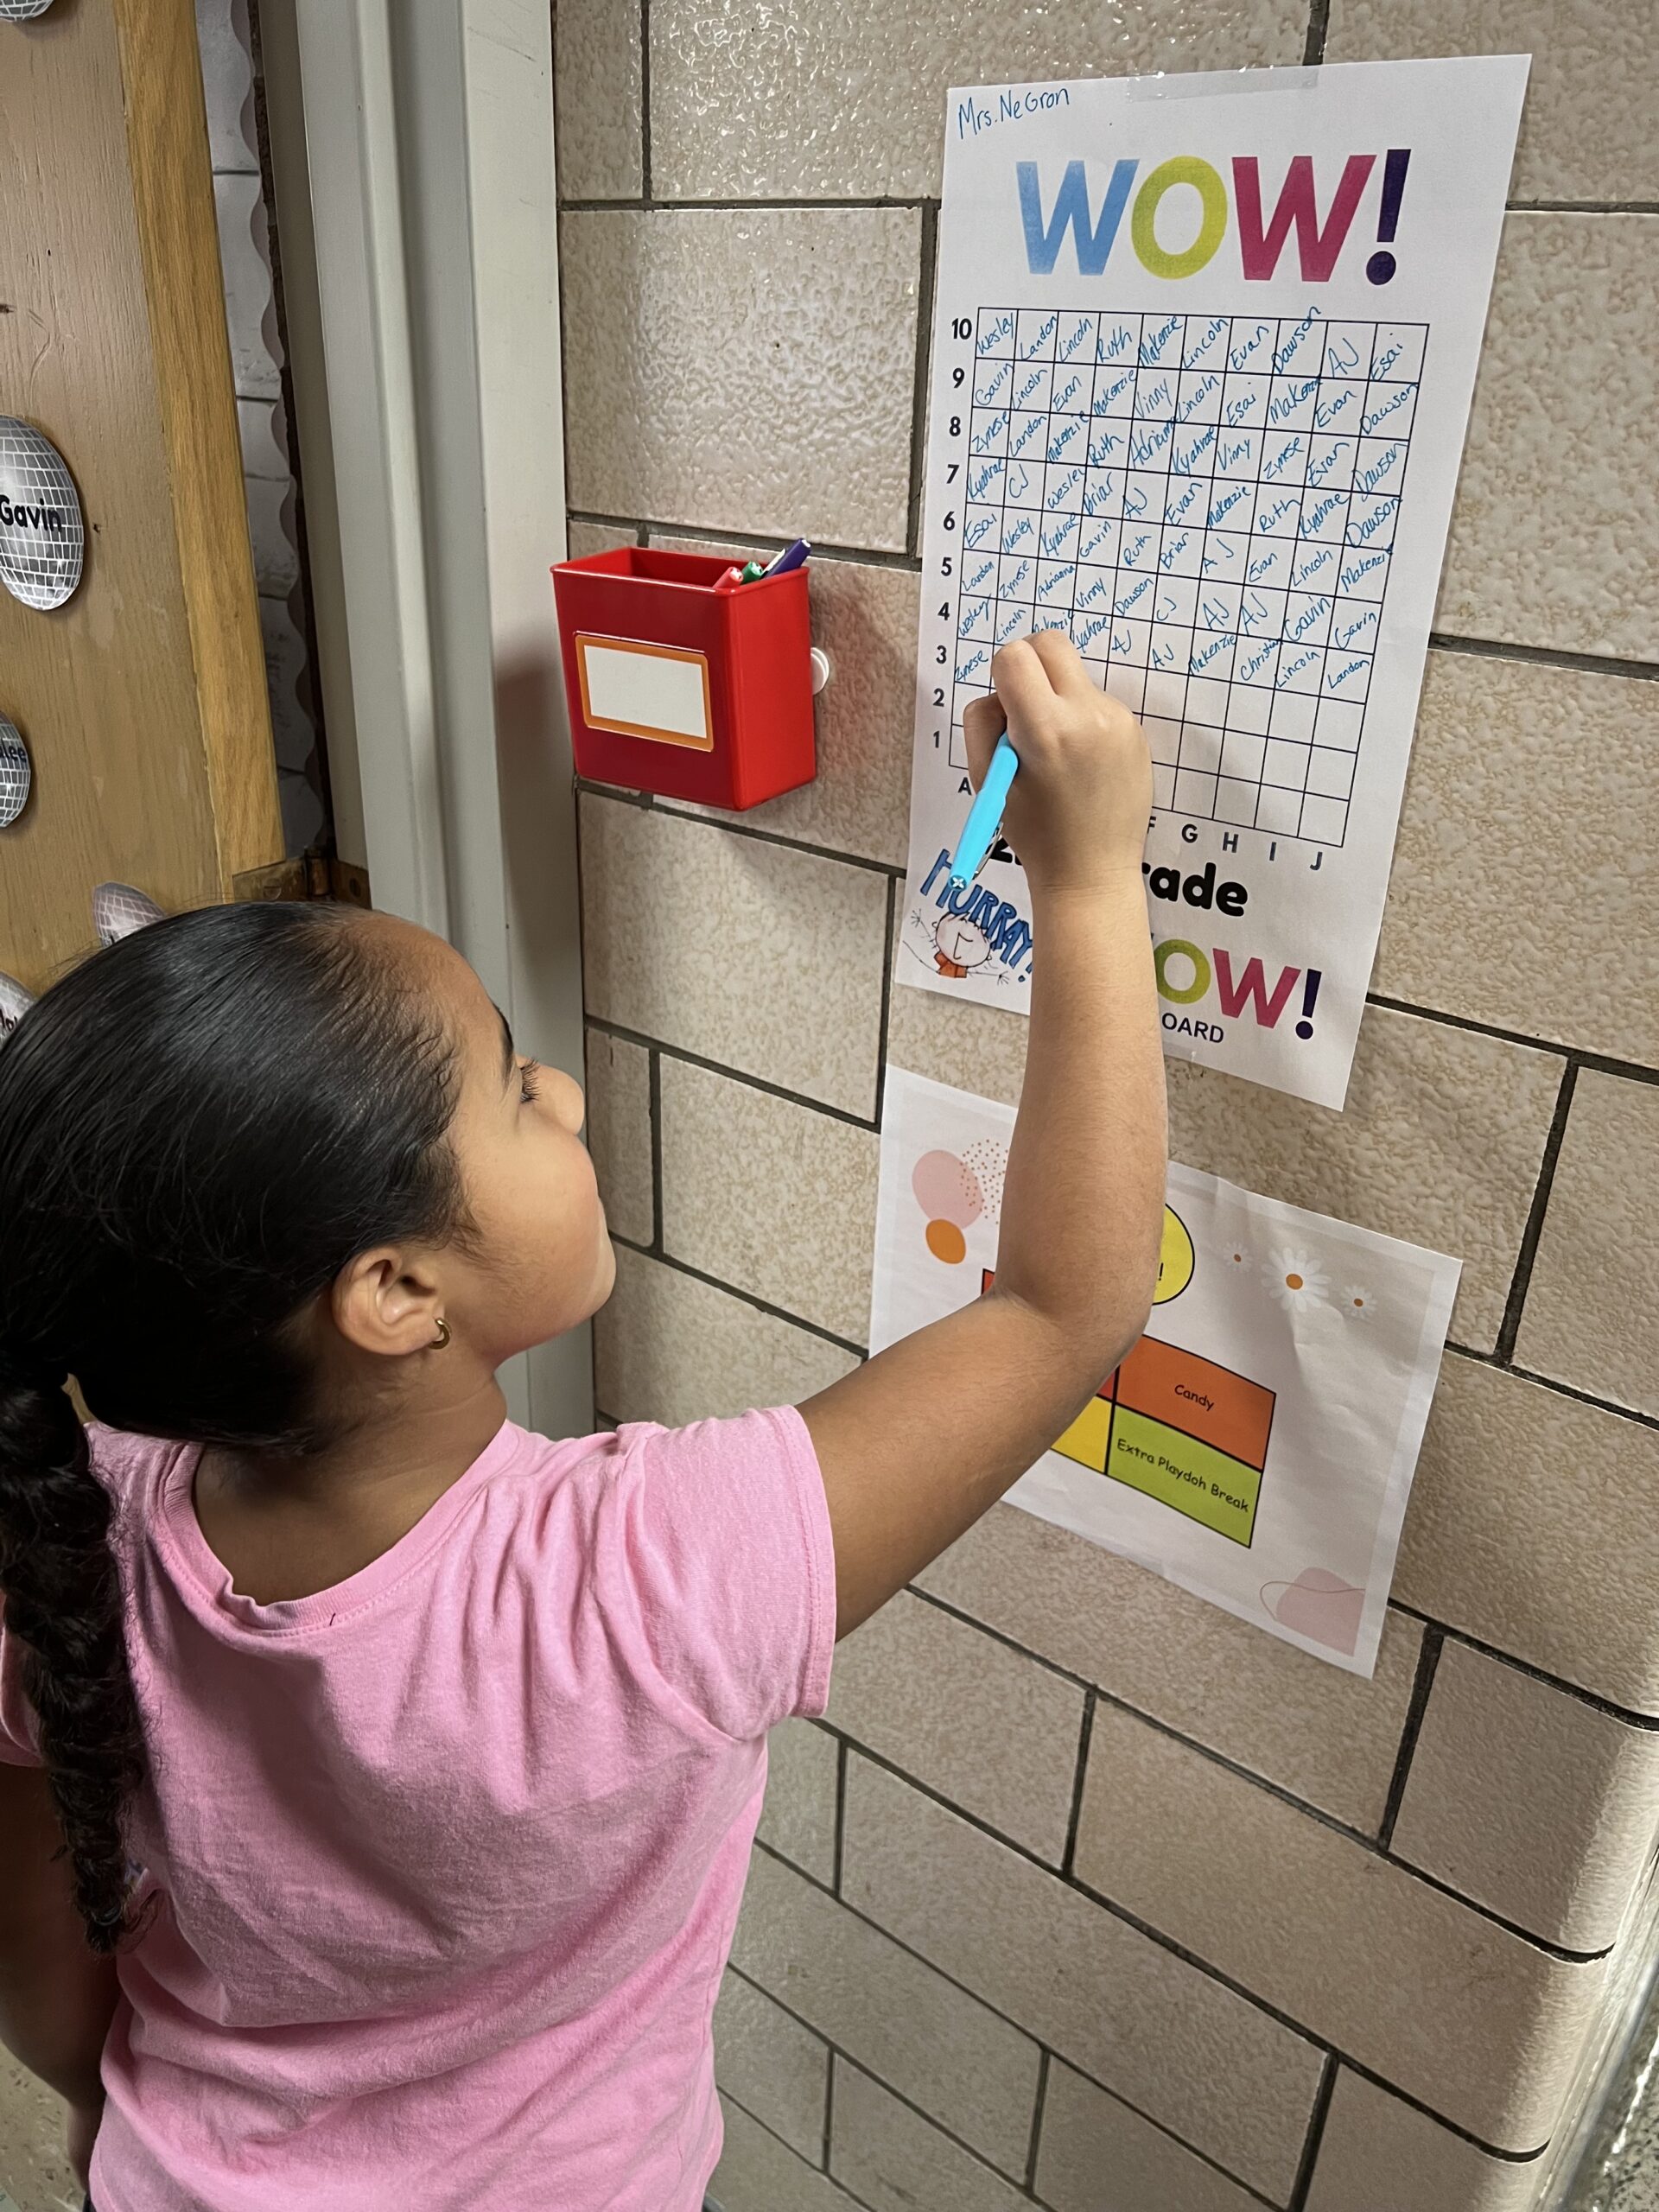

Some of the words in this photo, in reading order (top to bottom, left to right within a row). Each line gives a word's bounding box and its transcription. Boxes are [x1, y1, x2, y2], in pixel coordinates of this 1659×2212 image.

[958, 97, 997, 140] Mrs.
[1016, 149, 1412, 286] WOW!
[951, 318, 972, 340] 10
[976, 312, 1014, 355] Wesley
[1020, 315, 1058, 360] Landon
[1058, 318, 1093, 363] Lincoln
[1097, 326, 1133, 363] Ruth
[1181, 318, 1230, 369] Lincoln
[1230, 326, 1269, 371] Evan
[1271, 306, 1322, 375] Dawson
[1328, 337, 1359, 378] AJ
[1369, 332, 1403, 382] Esai
[952, 367, 965, 389] 9
[975, 363, 1014, 406] Gavin
[1010, 368, 1048, 410] Lincoln
[1052, 376, 1083, 411] Evan
[1135, 378, 1173, 419] Vinny
[1176, 375, 1221, 423] Lincoln
[1226, 382, 1256, 428] Esai
[1313, 390, 1357, 428] Evan
[1359, 383, 1420, 435] Dawson
[949, 416, 961, 436] 8
[947, 464, 959, 484] 7
[1008, 415, 1047, 458] Landon
[1087, 433, 1125, 469] Ruth
[1217, 439, 1250, 471] Vinny
[1306, 442, 1350, 487] Evan
[1351, 442, 1409, 503] Dawson
[0, 494, 62, 533] Gavin
[944, 511, 956, 531] 6
[1122, 487, 1148, 519] AJ
[1164, 482, 1203, 526] Evan
[1259, 499, 1302, 533] Ruth
[1346, 498, 1403, 549] Dawson
[940, 557, 952, 576] 5
[1079, 520, 1112, 558] Gavin
[1123, 534, 1152, 567] Ruth
[1160, 531, 1189, 570] Briar
[1249, 552, 1279, 583] Evan
[1290, 549, 1333, 587] Lincoln
[938, 602, 950, 620] 4
[961, 561, 995, 593] Landon
[1076, 577, 1107, 608] Vinny
[1114, 577, 1154, 616] Dawson
[1156, 597, 1178, 622] CJ
[1202, 598, 1230, 631] AJ
[1240, 591, 1268, 636] AJ
[1282, 596, 1332, 642] Gavin
[1334, 611, 1377, 650] Gavin
[936, 645, 947, 664] 3
[995, 608, 1027, 643] Lincoln
[1111, 629, 1133, 655] AJ
[1151, 643, 1175, 671] AJ
[1274, 651, 1321, 689] Lincoln
[1328, 659, 1370, 690] Landon
[933, 689, 944, 708] 2
[932, 731, 941, 749] 1
[958, 777, 971, 796] A
[1181, 823, 1198, 843] G
[1222, 832, 1239, 853] H
[1269, 842, 1277, 861] I
[1309, 851, 1323, 870] J
[1151, 938, 1322, 1039] OW!
[1161, 1013, 1224, 1043] OARD
[1174, 1384, 1215, 1412] Candy
[1117, 1438, 1154, 1464] Extra
[1158, 1456, 1206, 1490] Playdoh
[1211, 1483, 1249, 1512] Break
